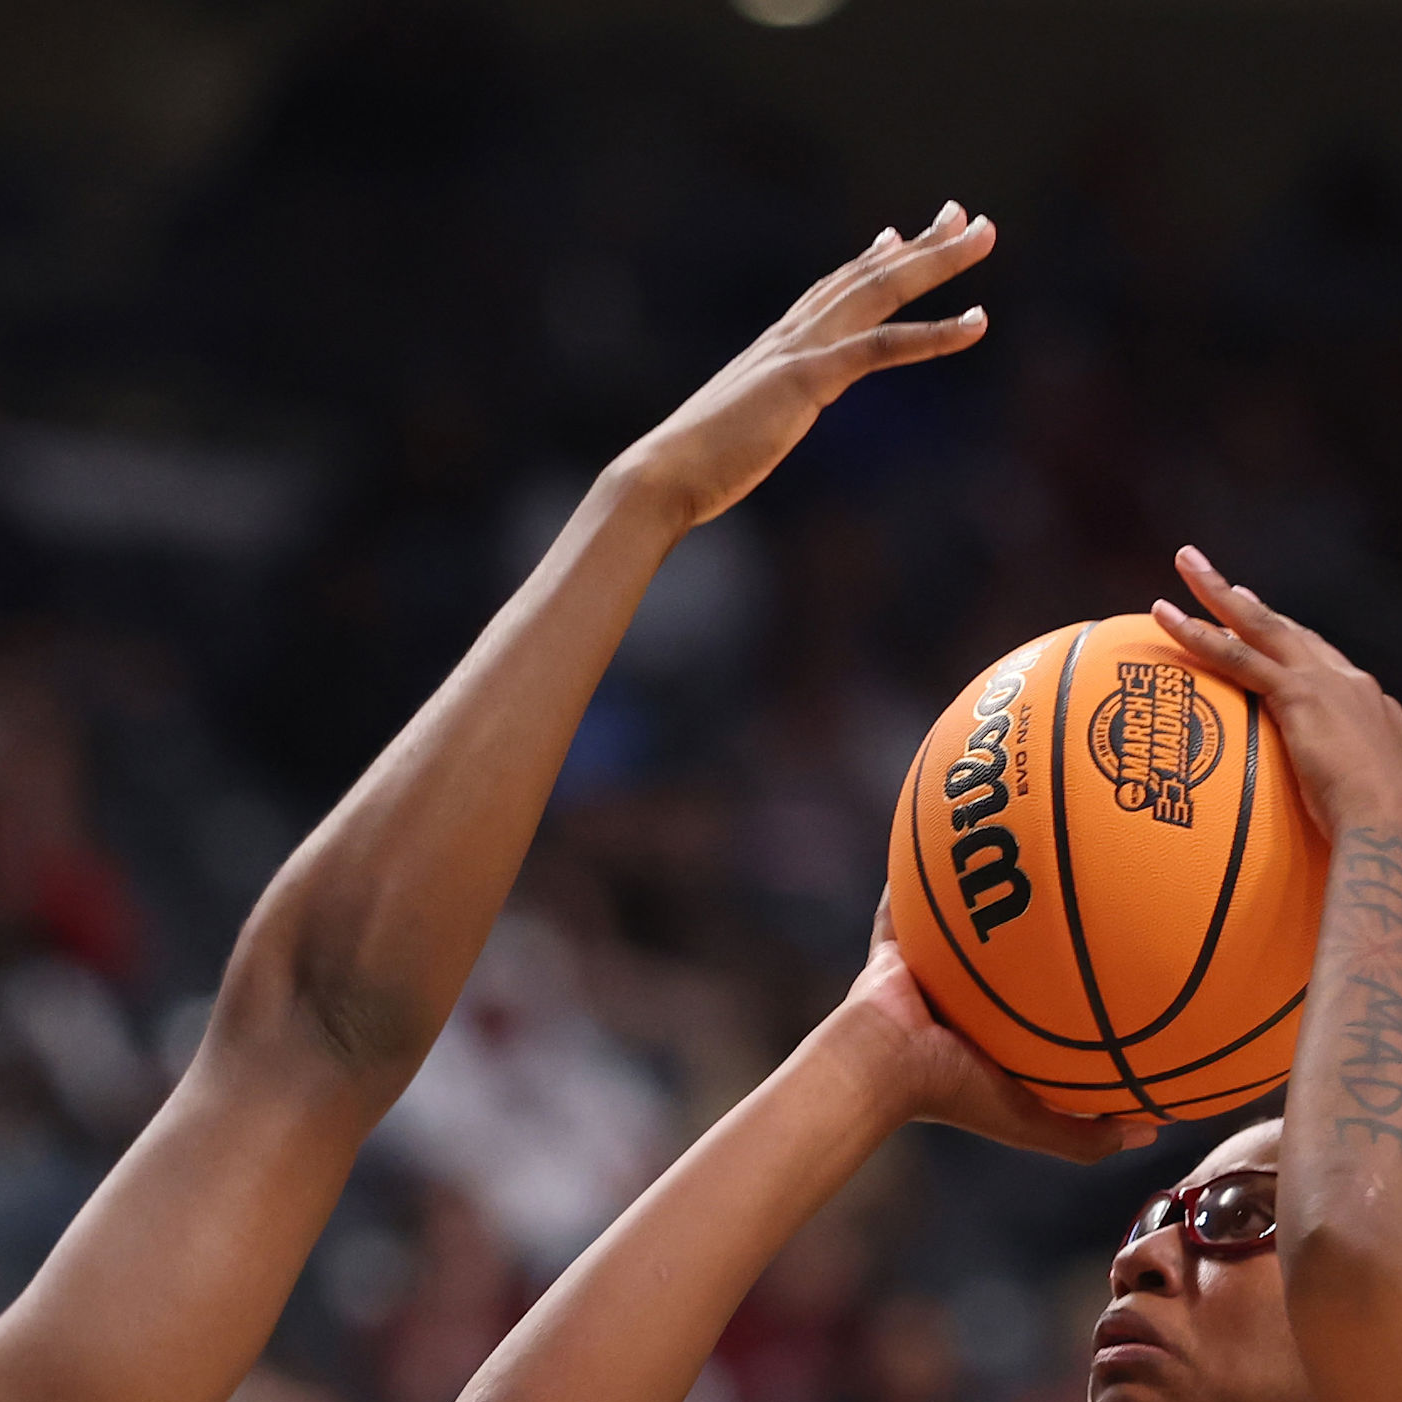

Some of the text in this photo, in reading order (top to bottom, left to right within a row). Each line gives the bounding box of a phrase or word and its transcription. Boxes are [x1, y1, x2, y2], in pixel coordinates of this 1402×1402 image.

[1016, 703, 1032, 797] EVO NXT
[1121, 696, 1154, 782] MARCH
[1151, 665, 1185, 773] MADNESS
[944, 636, 1057, 944] Wilson
